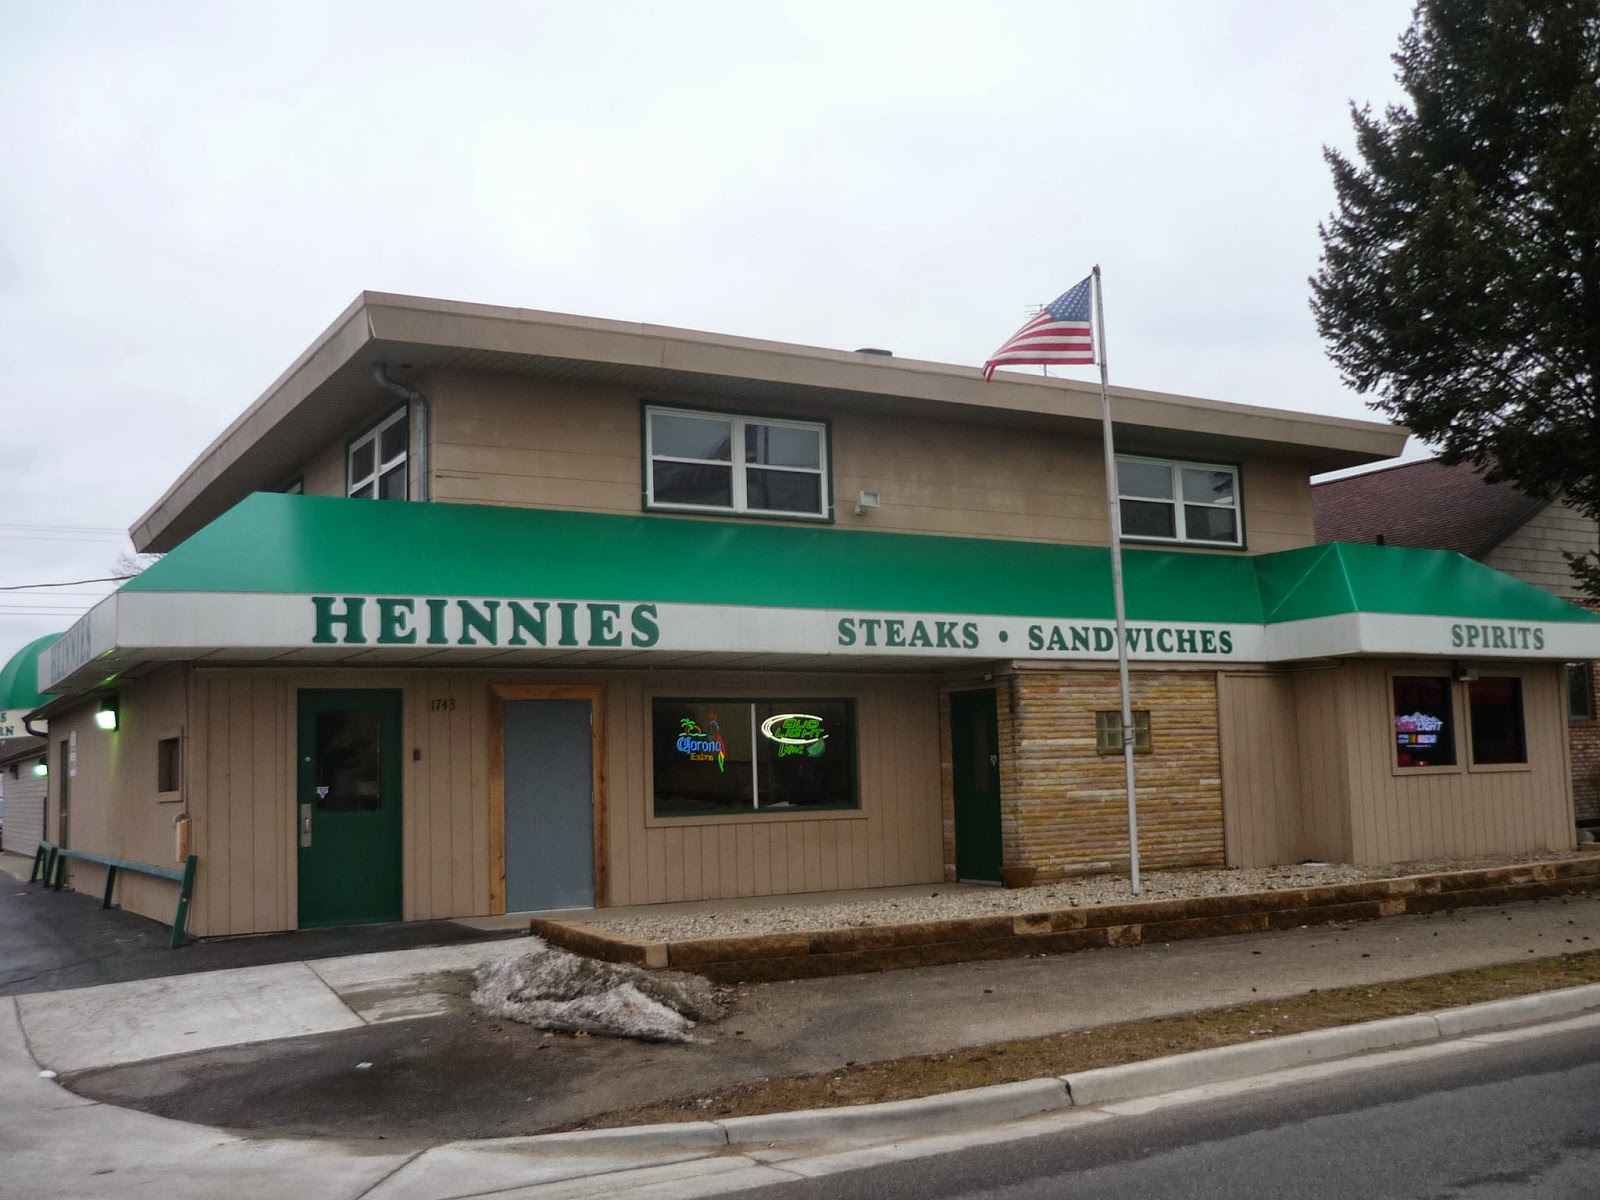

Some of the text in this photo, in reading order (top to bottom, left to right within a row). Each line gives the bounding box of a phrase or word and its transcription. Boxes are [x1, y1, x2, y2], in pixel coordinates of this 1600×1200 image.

[311, 596, 660, 648] HEINNIES
[838, 618, 1233, 654] STEAKS SANDWICHES
[1452, 624, 1545, 650] SPIRITS
[783, 718, 819, 729] BUD
[1416, 721, 1443, 731] LIGHT
[775, 728, 824, 738] LIGHT
[677, 737, 722, 754] Corona
[690, 752, 714, 761] Extra
